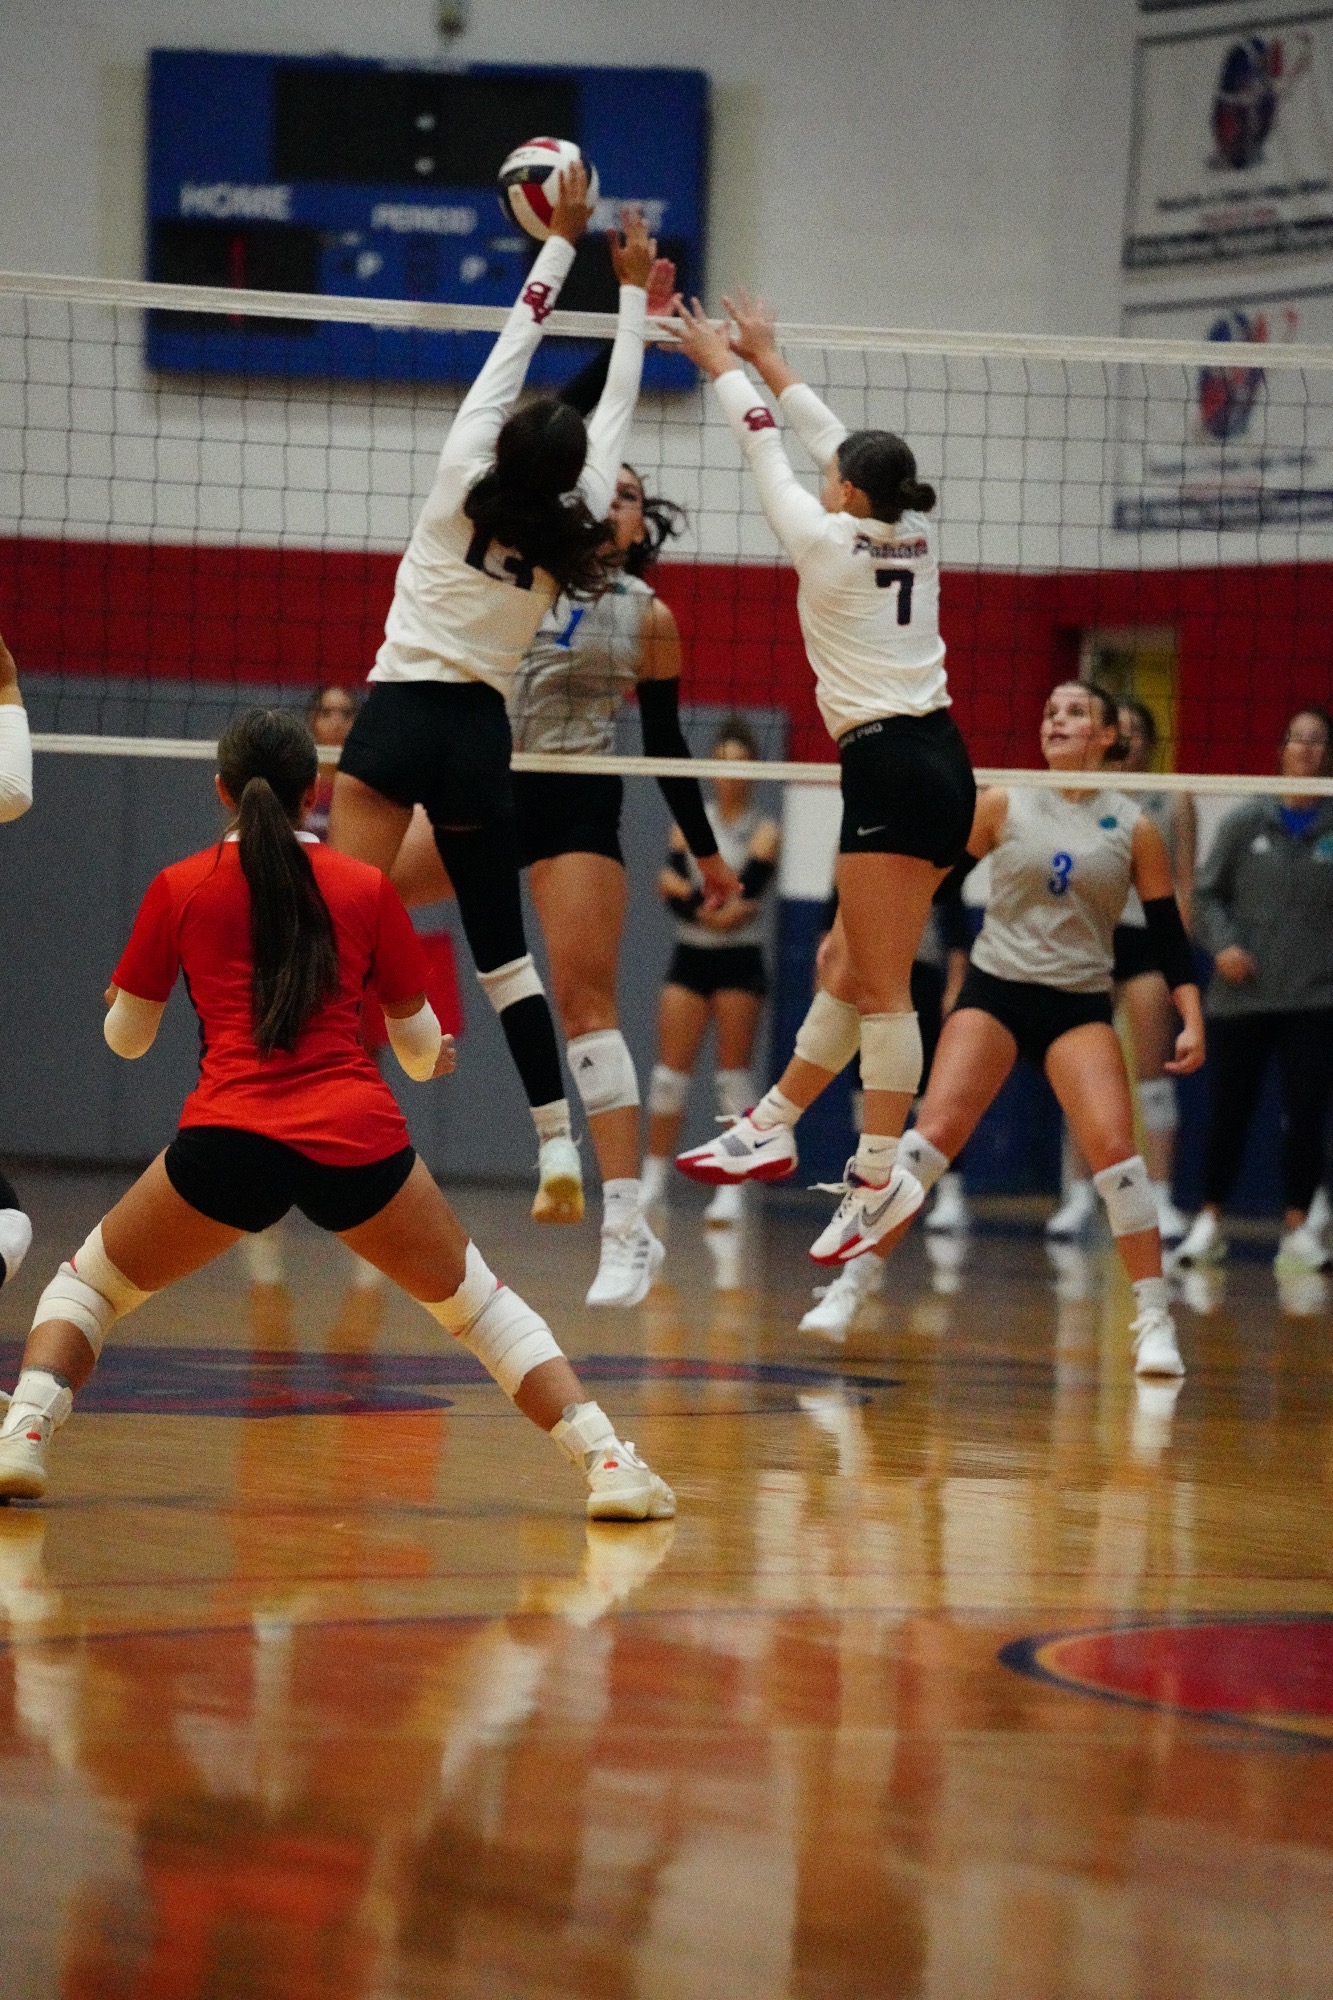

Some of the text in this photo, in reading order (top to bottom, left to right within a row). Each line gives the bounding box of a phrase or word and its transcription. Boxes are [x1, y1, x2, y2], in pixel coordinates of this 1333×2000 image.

[180, 183, 290, 220] HOME
[875, 568, 914, 625] 7
[1049, 852, 1073, 895] 3
